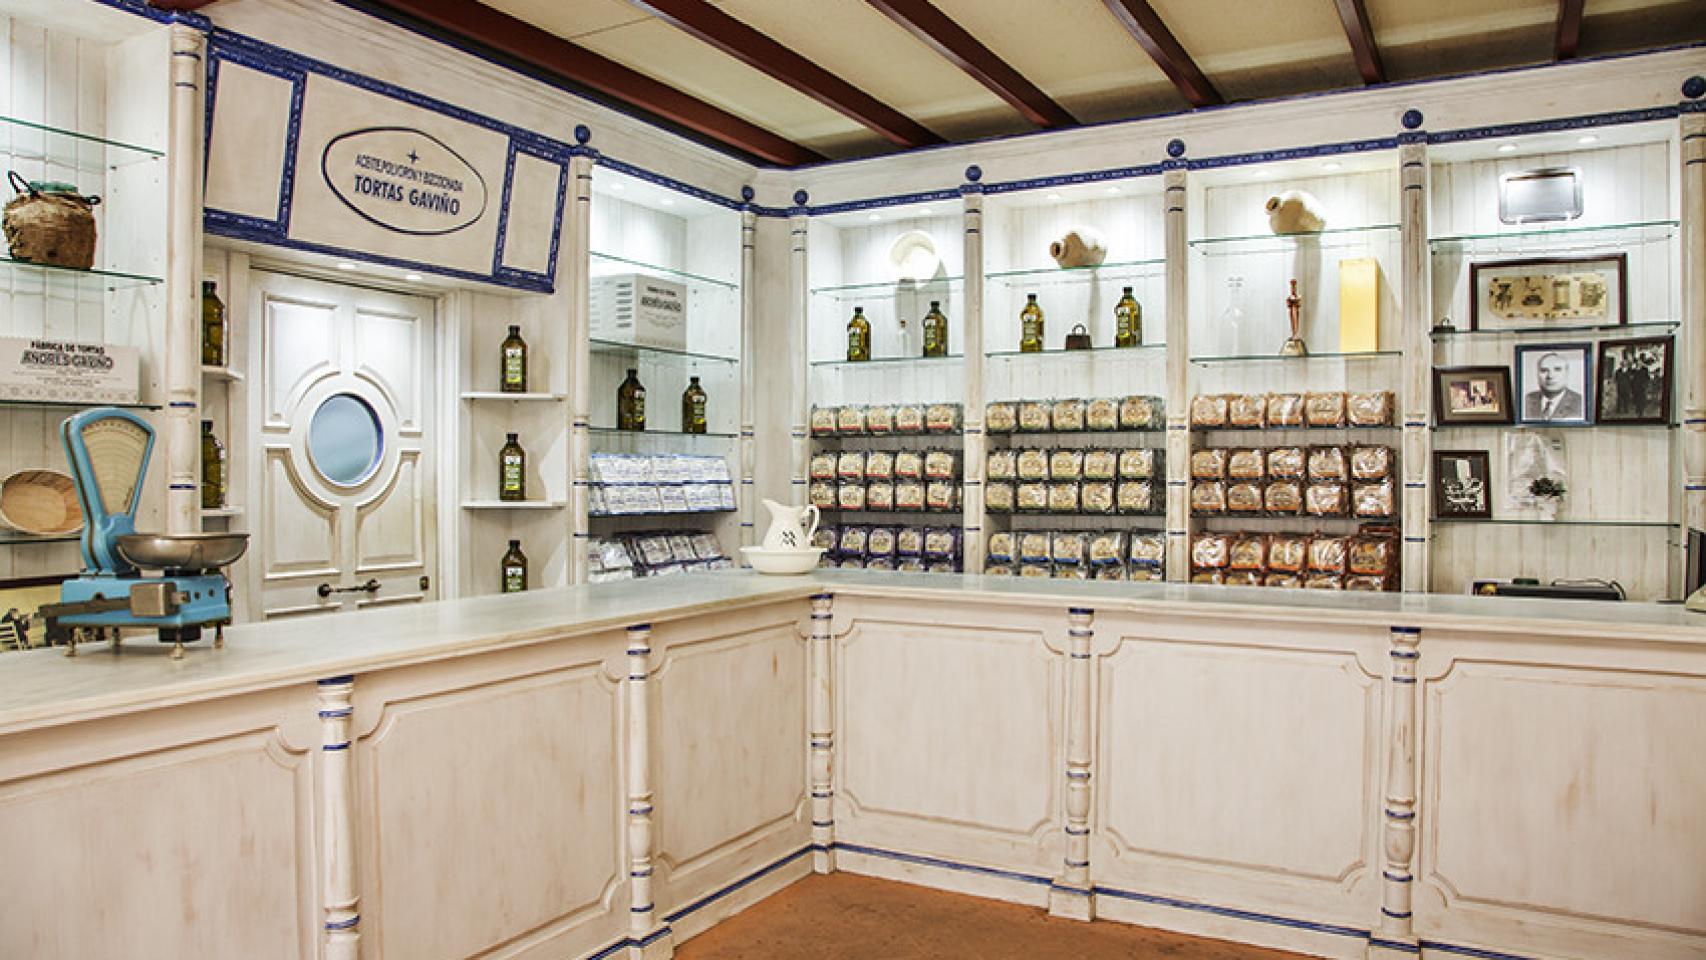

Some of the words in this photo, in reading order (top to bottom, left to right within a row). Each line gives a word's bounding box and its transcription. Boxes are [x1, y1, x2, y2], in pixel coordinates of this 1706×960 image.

[355, 174, 404, 201] TORTAS
[409, 189, 461, 215] GAVIÑO
[65, 342, 75, 353] DE
[77, 344, 105, 355] TORTAS
